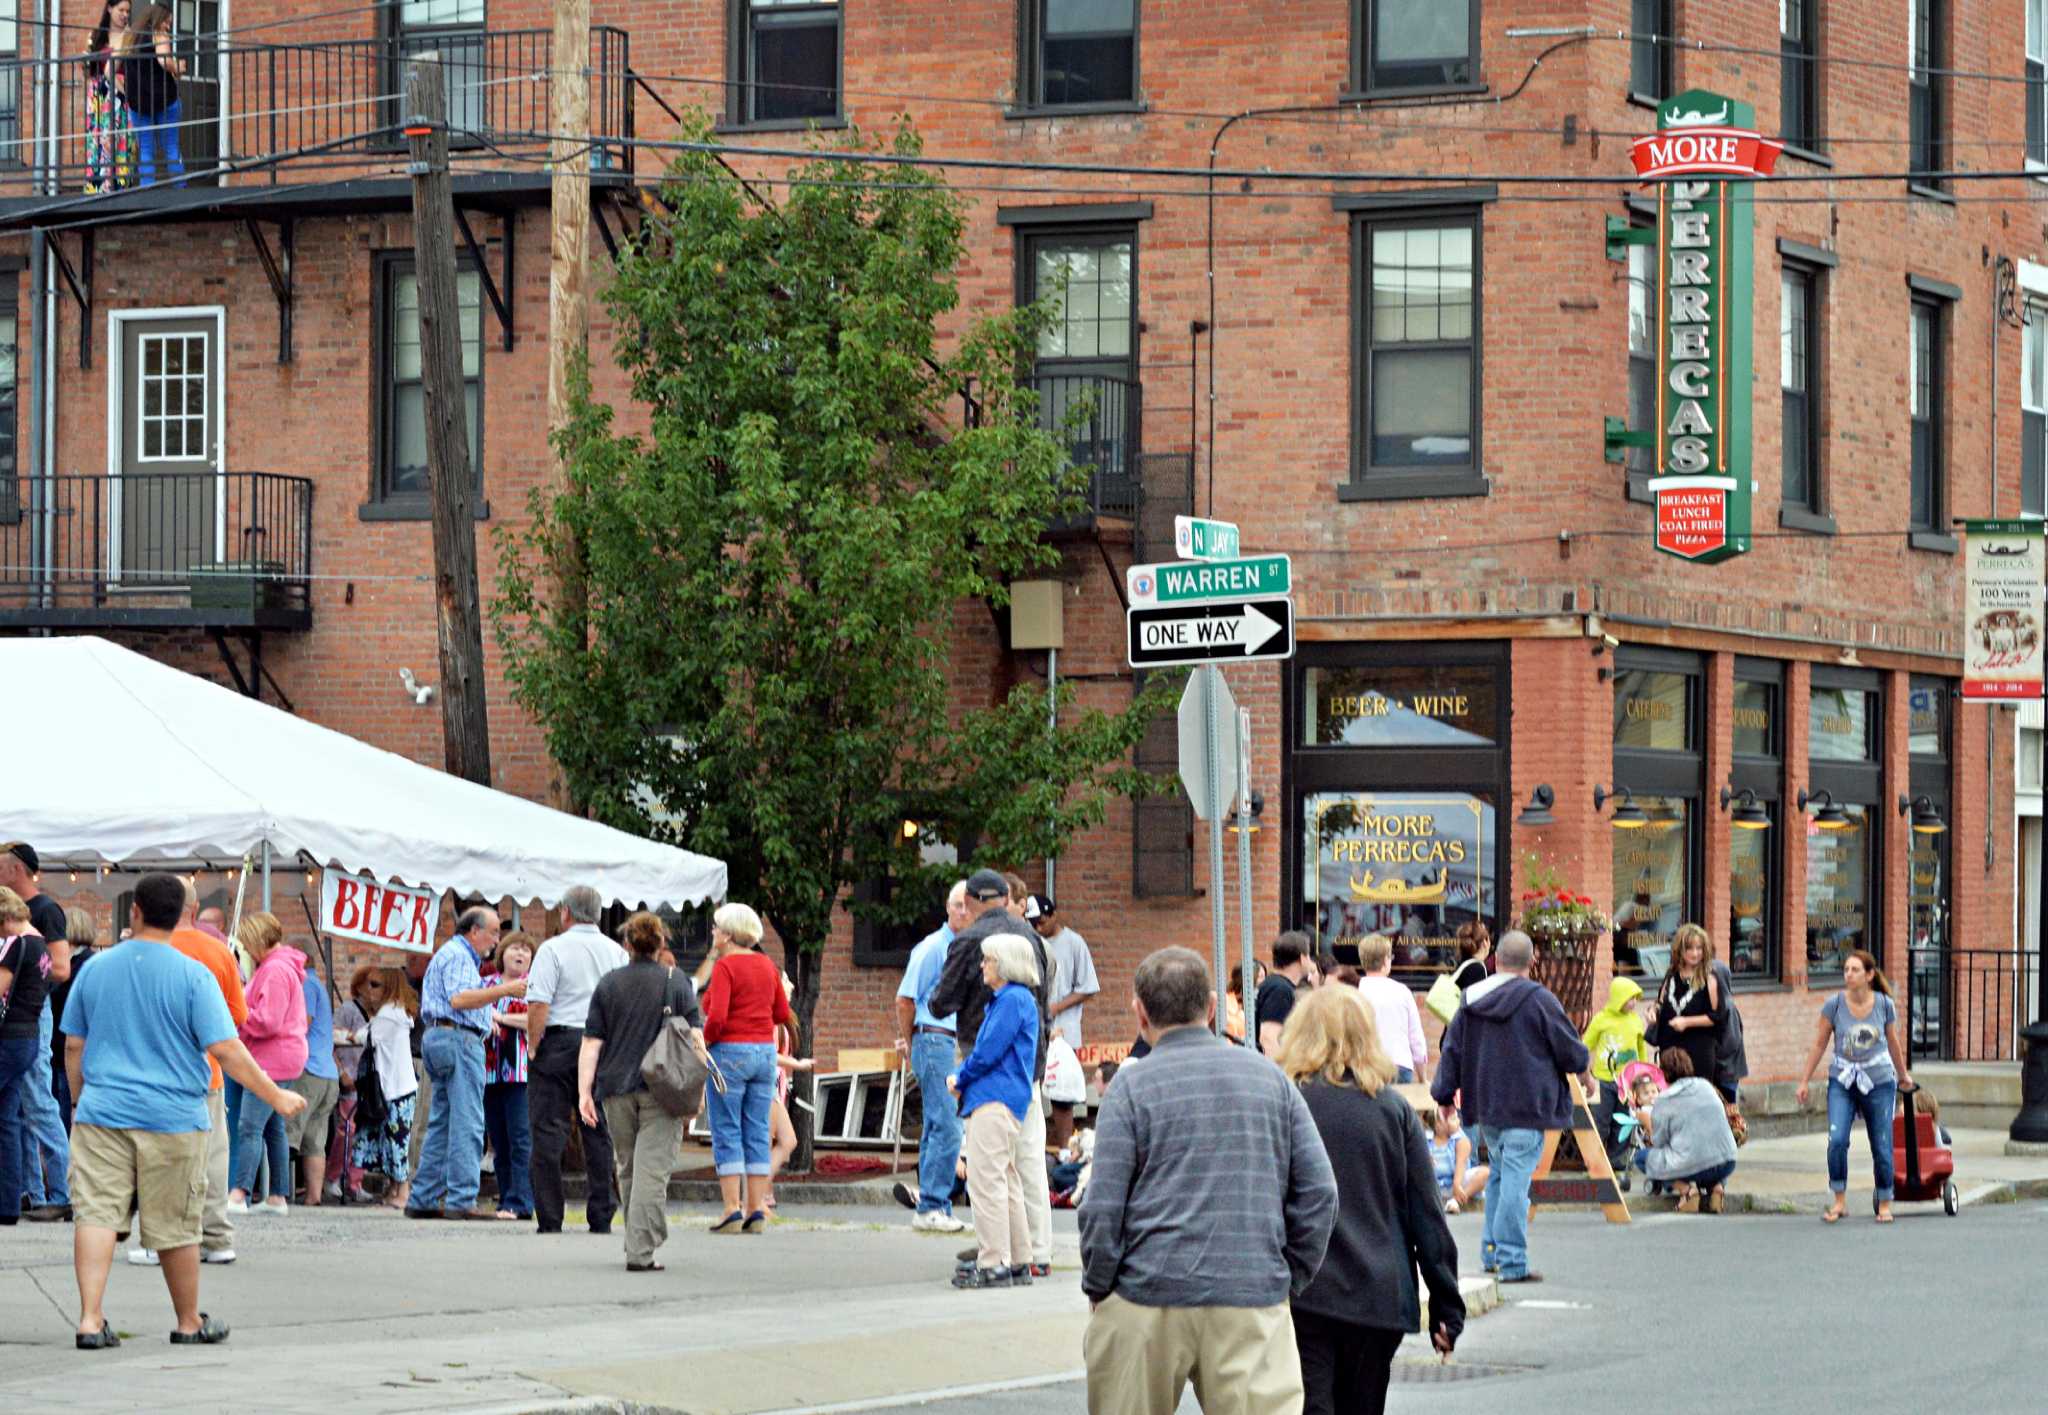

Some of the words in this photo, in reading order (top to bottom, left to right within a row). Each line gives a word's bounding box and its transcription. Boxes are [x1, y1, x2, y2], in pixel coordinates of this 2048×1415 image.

[1649, 136, 1738, 169] MORE
[1667, 180, 1713, 475] PERRECAS
[1660, 494, 1722, 507] BREAKFAST
[1672, 506, 1710, 519] LUNCH
[1660, 520, 1688, 532] COAL
[1691, 519, 1722, 531] FIRED
[1194, 527, 1204, 552] N
[1211, 528, 1229, 554] JAY
[1675, 534, 1708, 545] PIZZA
[1166, 565, 1260, 595] WARREN
[1268, 563, 1279, 577] ST
[1980, 588, 1999, 599] 100
[2002, 588, 2031, 599] Years
[1146, 624, 1188, 646] ONE
[1197, 620, 1240, 642] WAY
[1330, 696, 1389, 716] BEER
[1413, 696, 1469, 716] WINE
[1363, 815, 1435, 837] MORE
[1332, 839, 1466, 863] PERRECA'S
[332, 878, 430, 945] BEER
[1397, 935, 1408, 945] All
